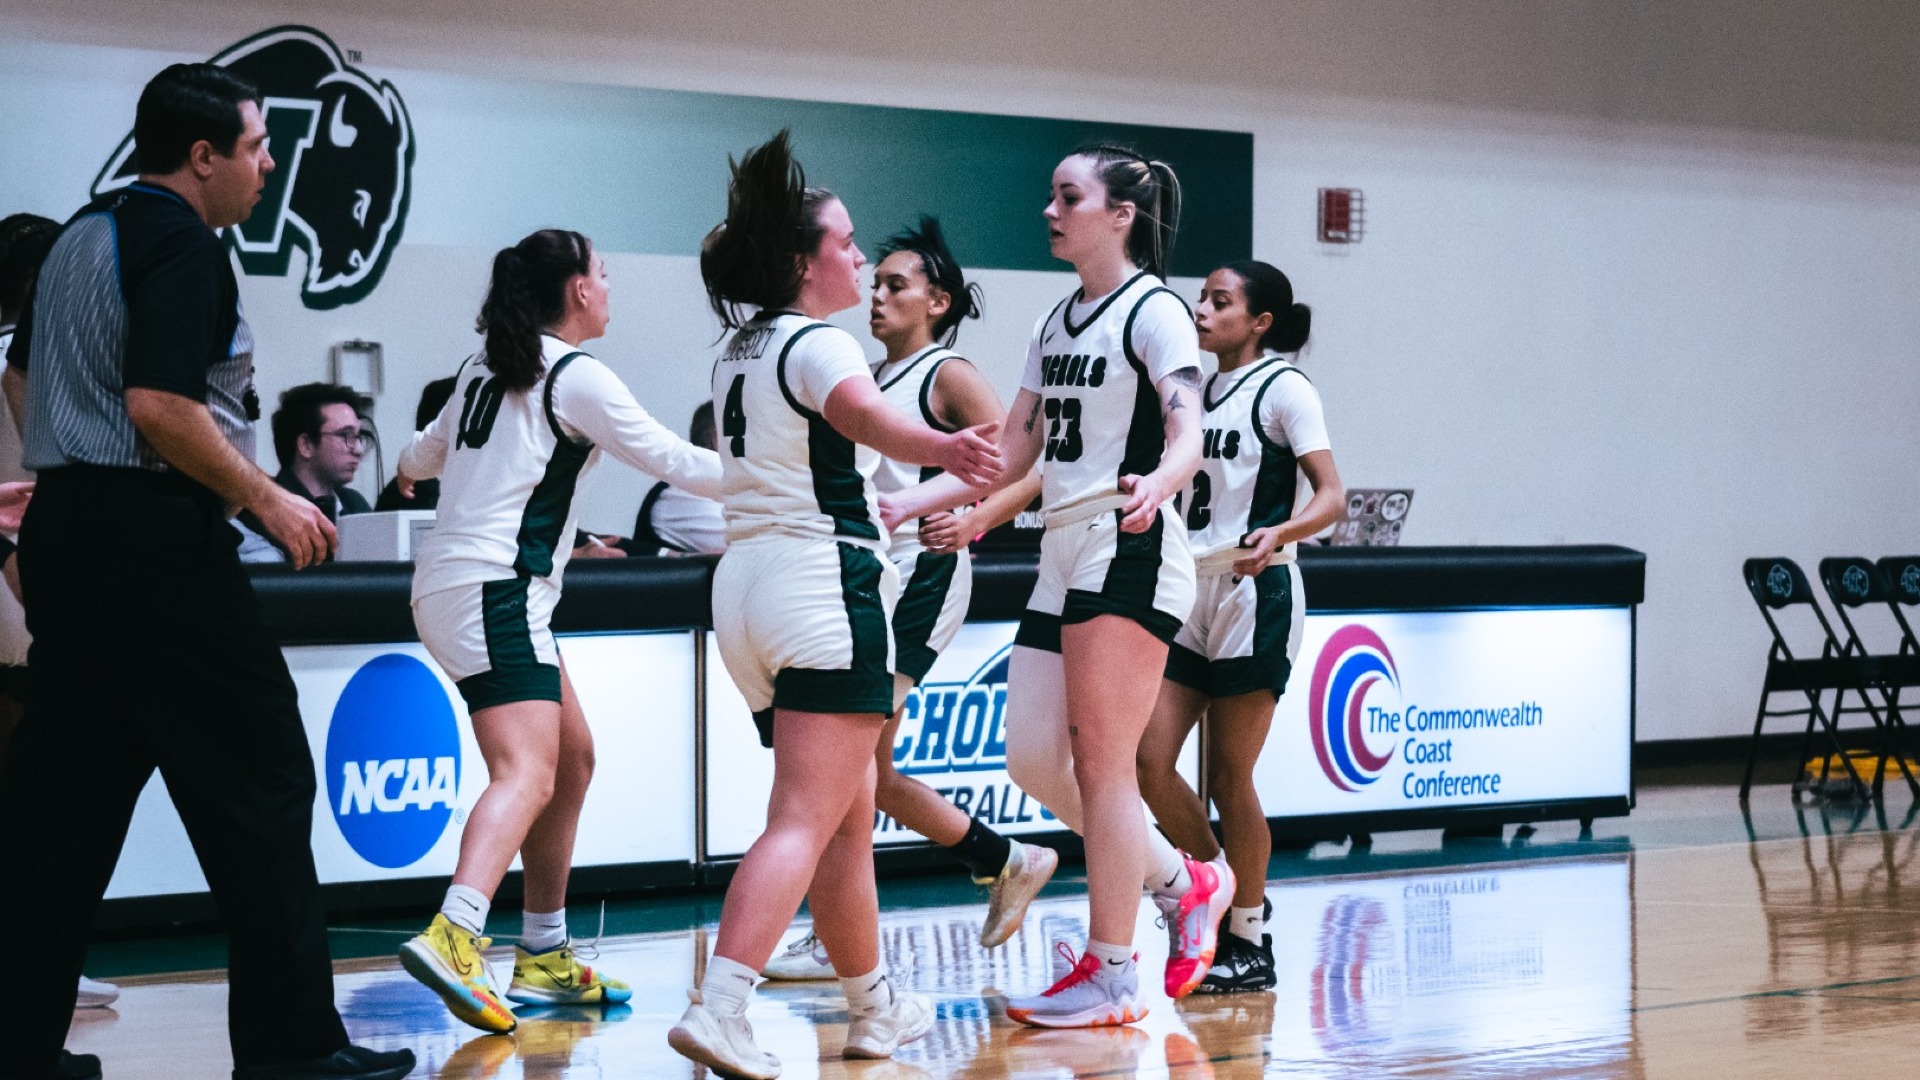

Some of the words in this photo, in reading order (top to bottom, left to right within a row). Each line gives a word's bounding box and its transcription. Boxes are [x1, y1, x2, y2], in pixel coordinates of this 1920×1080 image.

[347, 50, 362, 63] TM
[456, 376, 507, 451] 10
[723, 373, 746, 458] 4
[1044, 397, 1084, 463] 23
[1014, 510, 1044, 529] BONUS
[892, 686, 1008, 764] CHOL
[1367, 706, 1400, 733] The
[1405, 700, 1542, 732] Commonwealth
[1403, 737, 1452, 765] Coast
[339, 756, 457, 816] NCAA
[1403, 769, 1501, 799] Conference
